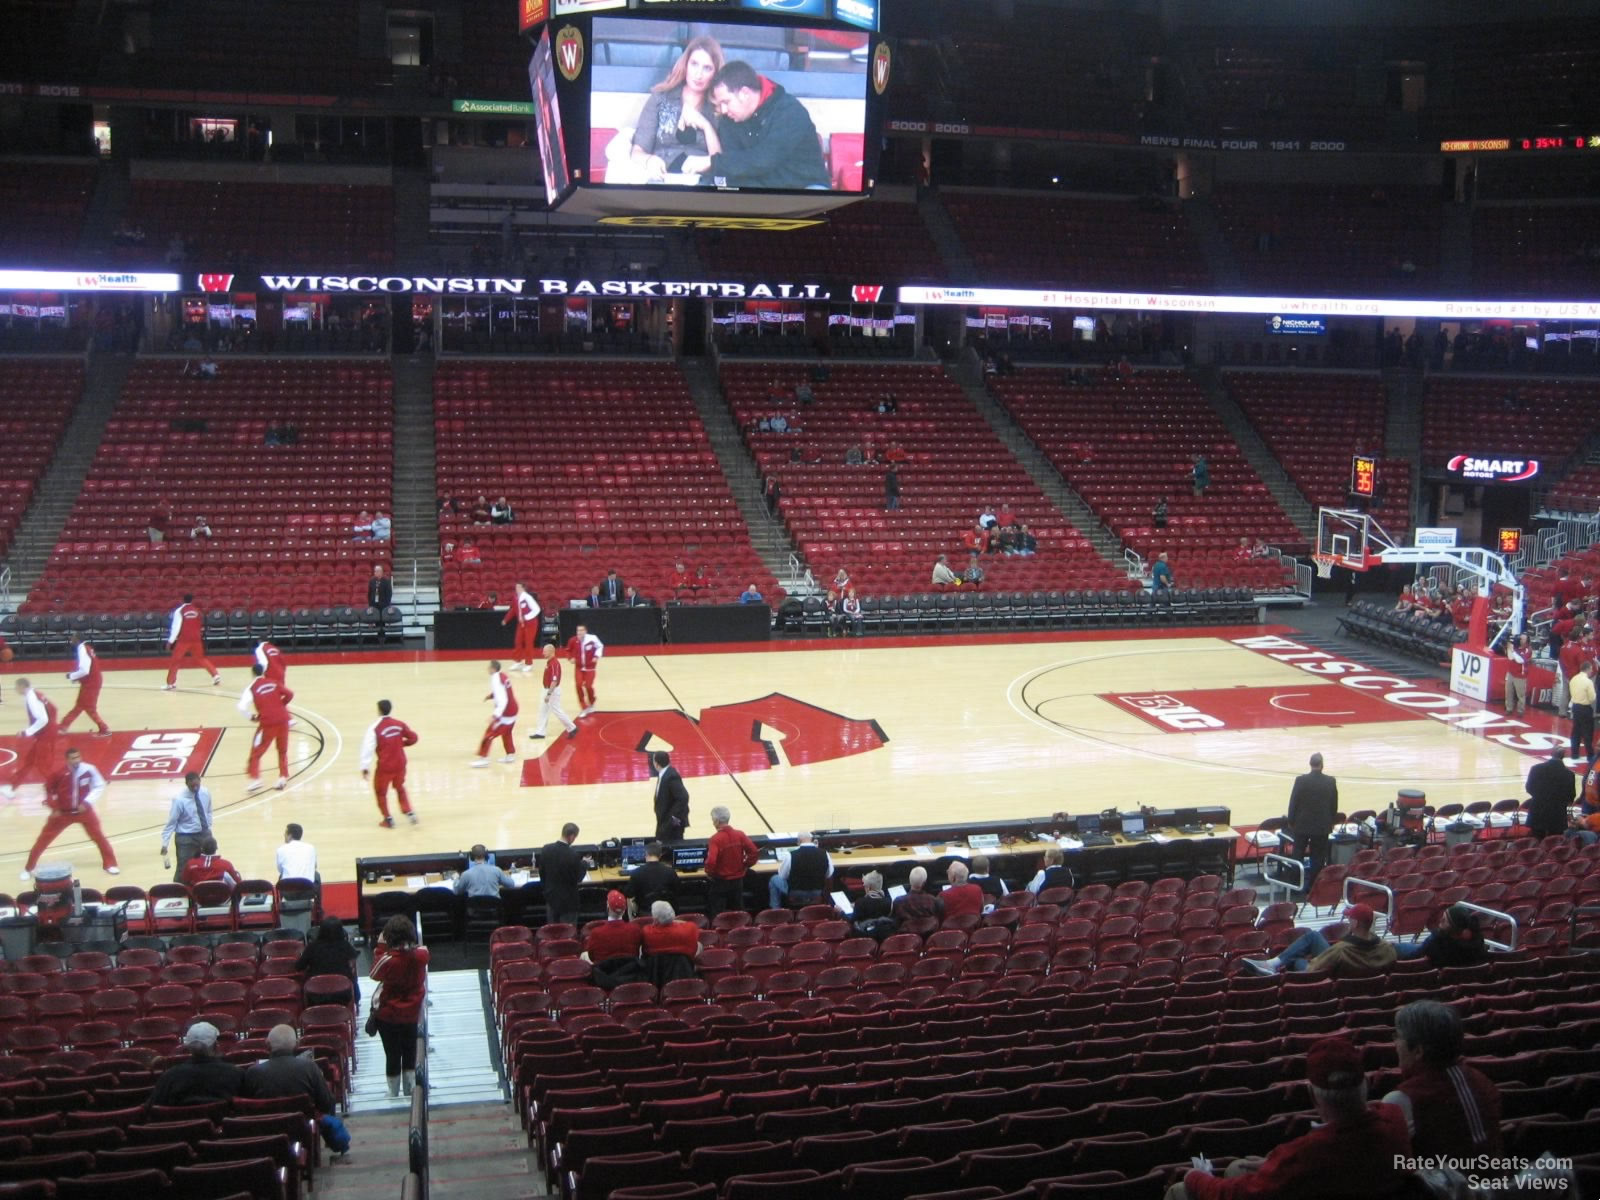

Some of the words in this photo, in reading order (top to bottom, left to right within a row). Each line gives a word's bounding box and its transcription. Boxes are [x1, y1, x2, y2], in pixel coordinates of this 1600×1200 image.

[561, 43, 577, 71] W
[1140, 135, 1180, 146] MEN'S
[1183, 137, 1218, 149] FINAL
[1222, 140, 1259, 150] FOUR
[1269, 141, 1301, 150] 1941
[1310, 141, 1345, 151] 2000
[1472, 139, 1510, 150] WISCONSIN
[199, 274, 235, 292] W
[260, 275, 527, 294] WISCONSIN
[539, 279, 831, 299] BASKETBALL
[851, 285, 883, 303] W
[1064, 294, 1122, 305] Hospital
[1128, 296, 1141, 305] in
[1147, 297, 1216, 308] Wisconsin
[1280, 301, 1380, 313] uwhealth.org
[1445, 303, 1502, 314] Ranked
[1534, 304, 1551, 316] by
[1559, 305, 1580, 315] US
[1463, 457, 1524, 473] SMART
[1463, 471, 1494, 479] MOTORS
[1461, 652, 1481, 677] yp
